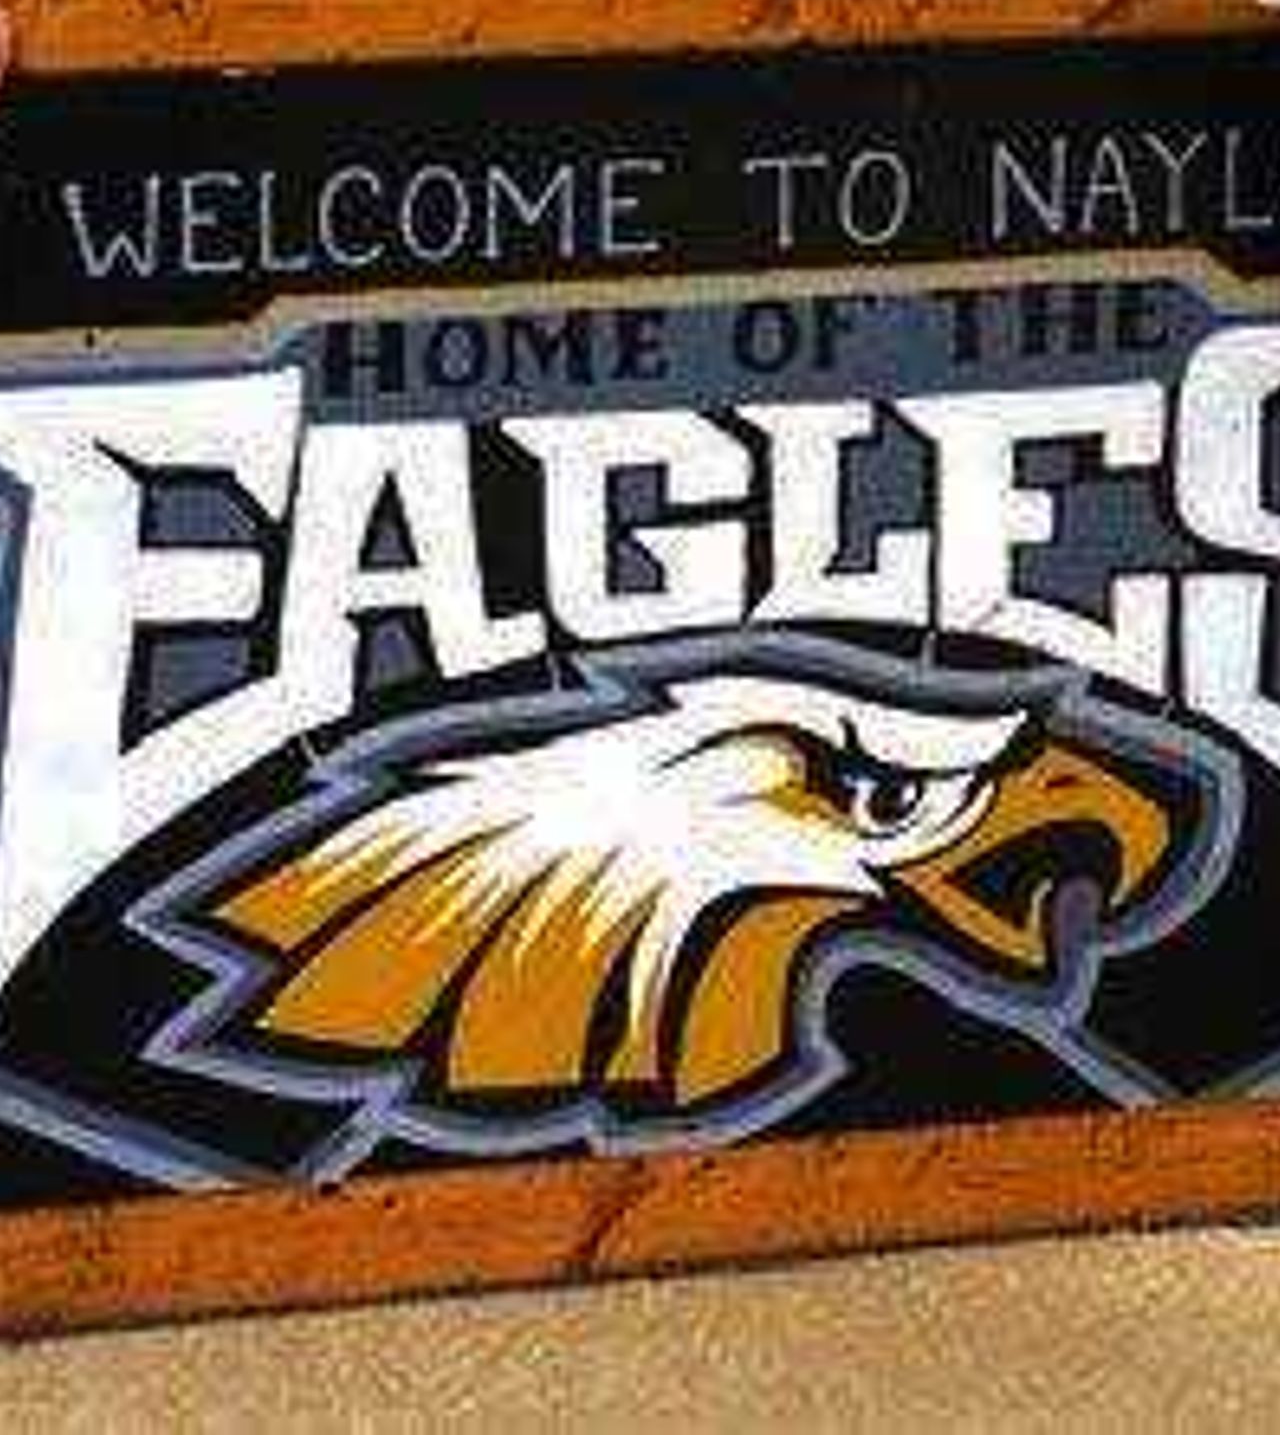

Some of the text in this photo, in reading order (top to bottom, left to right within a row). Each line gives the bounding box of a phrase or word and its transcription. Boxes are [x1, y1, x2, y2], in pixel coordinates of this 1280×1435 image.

[61, 158, 665, 278] WELCOME
[743, 150, 910, 248] TO
[323, 277, 1173, 398] HOME OF THE
